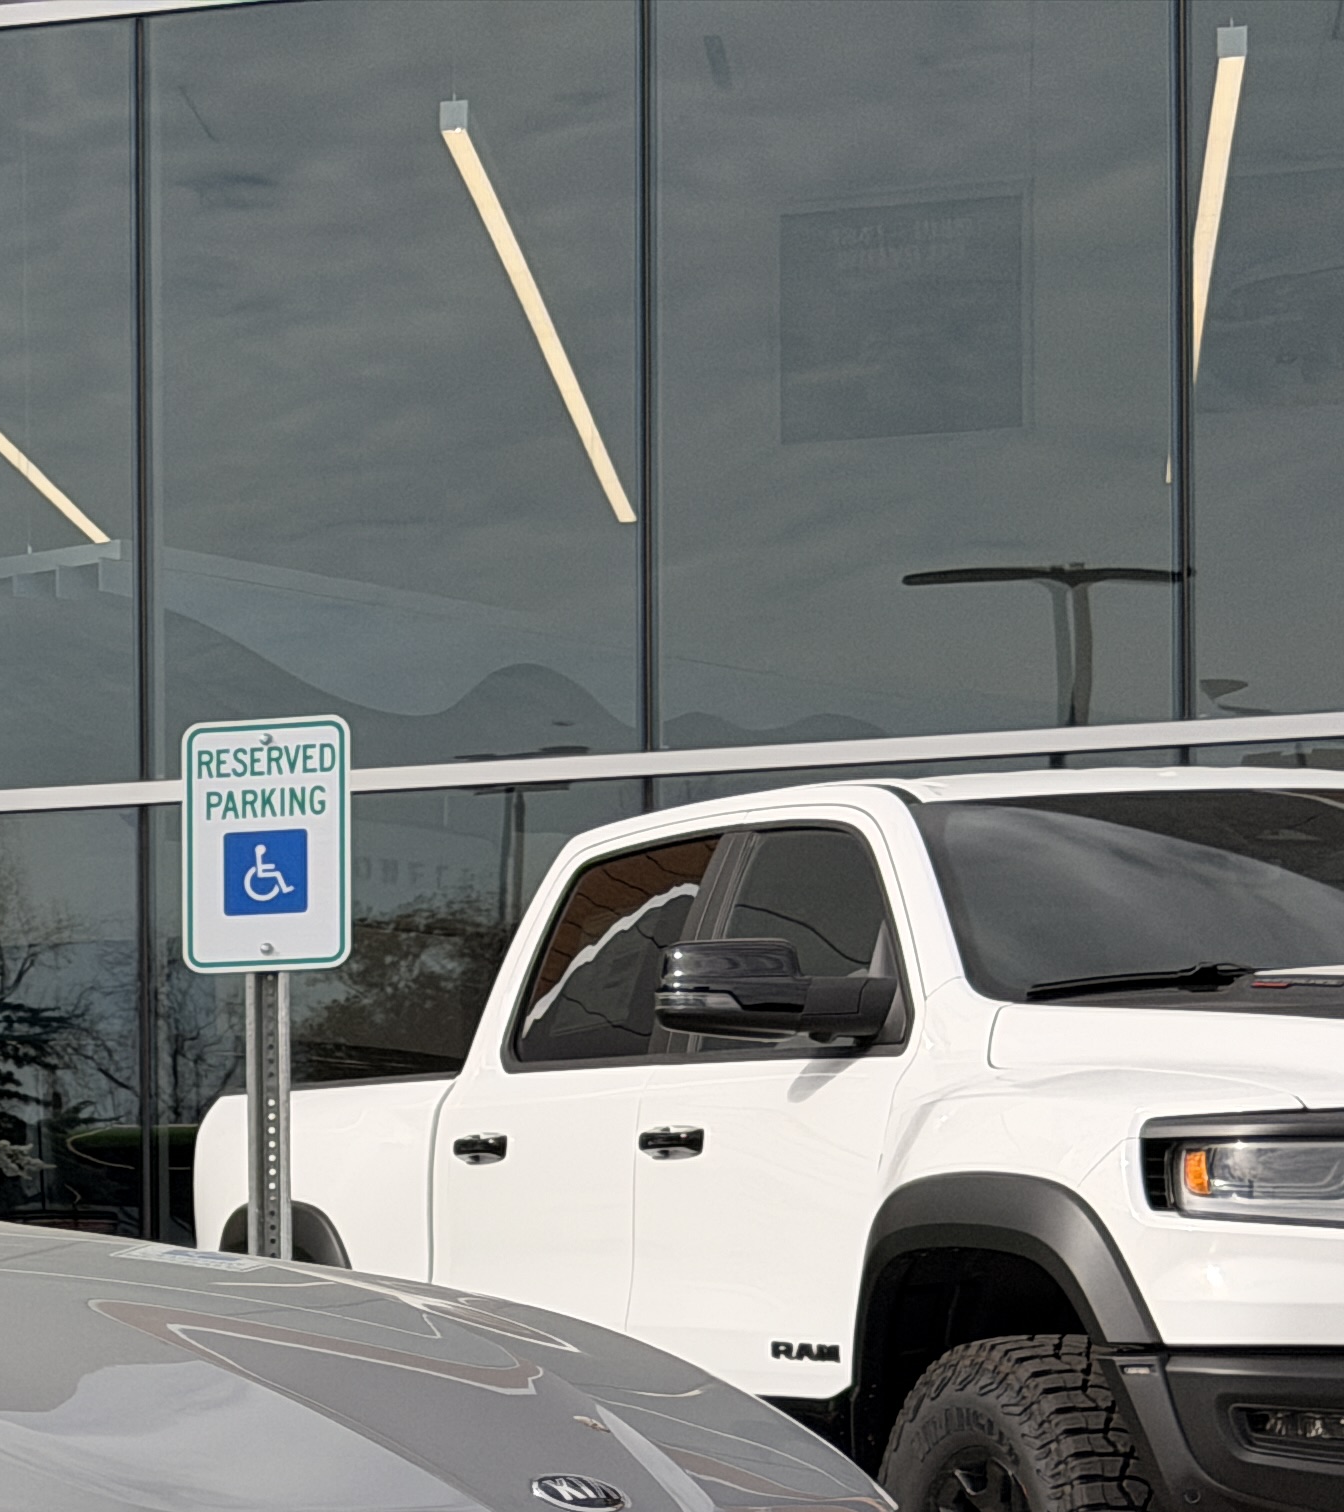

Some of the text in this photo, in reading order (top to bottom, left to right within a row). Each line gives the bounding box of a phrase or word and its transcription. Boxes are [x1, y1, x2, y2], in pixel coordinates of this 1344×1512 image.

[197, 743, 336, 779] RESERVED
[206, 785, 326, 820] PARKING
[771, 1341, 841, 1364] RAM
[542, 1477, 620, 1501] KIA
